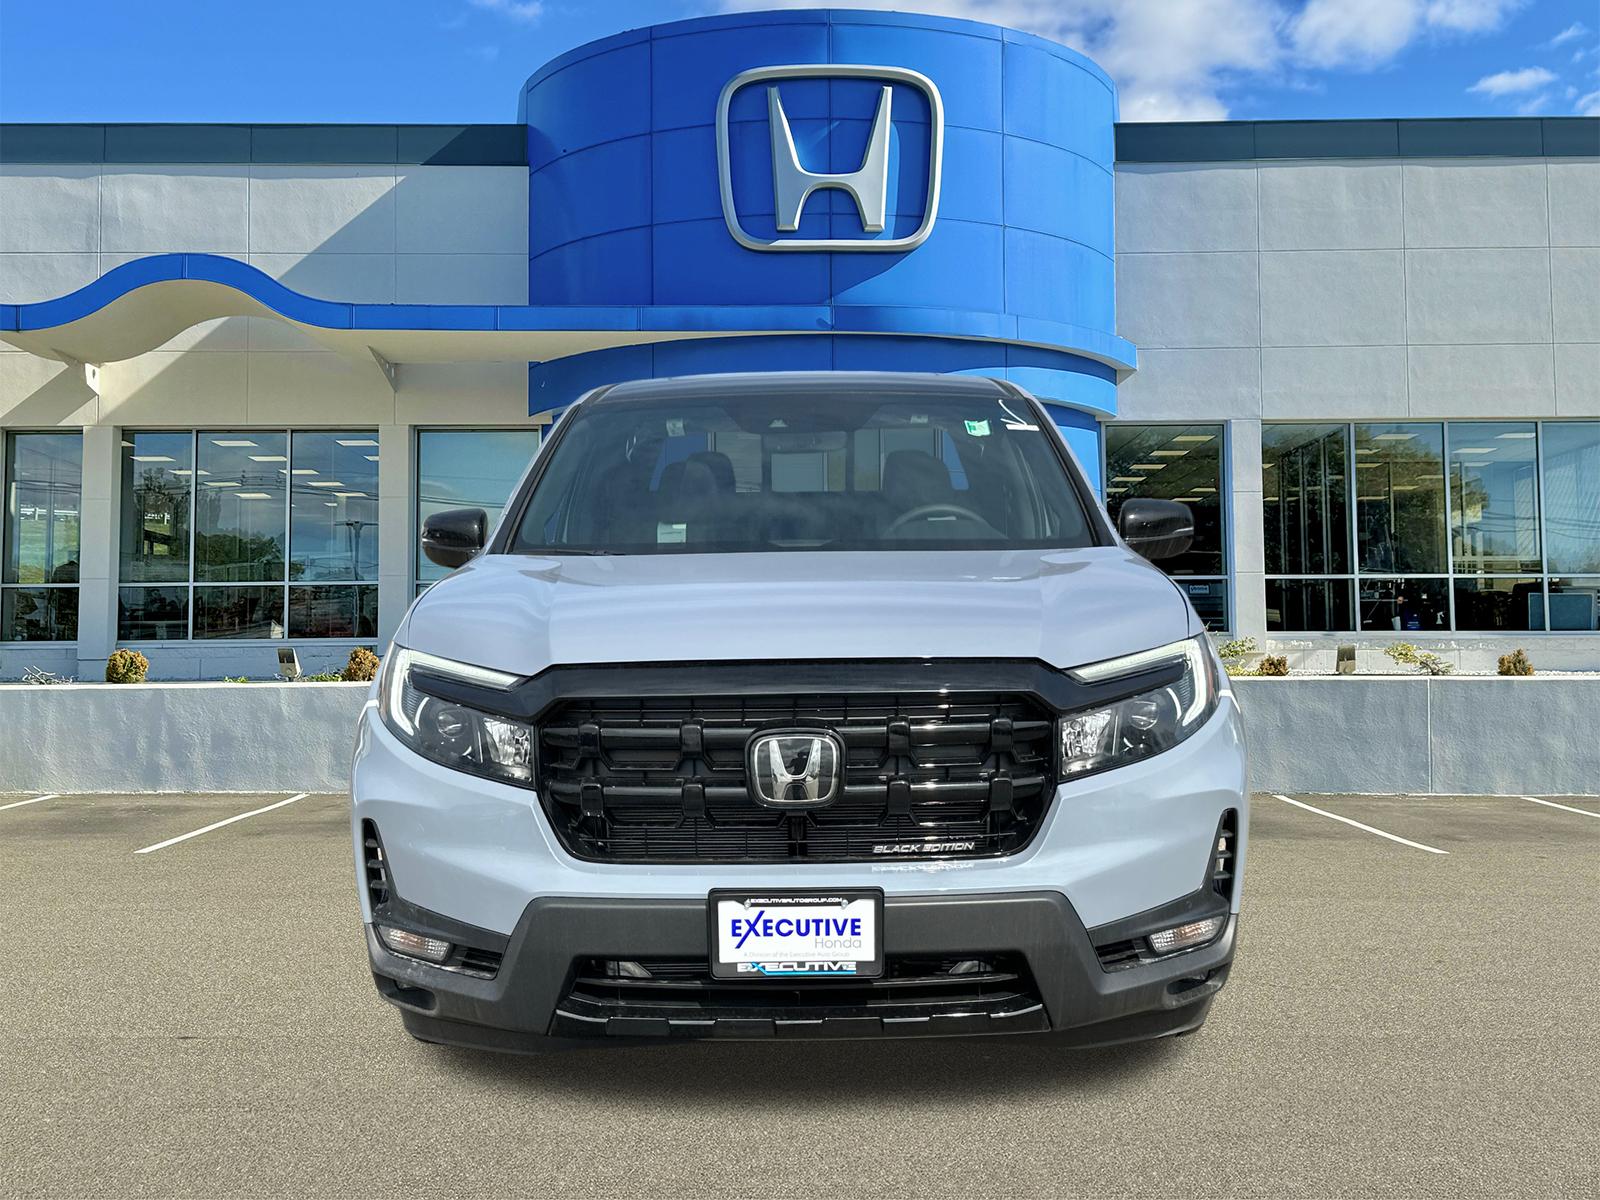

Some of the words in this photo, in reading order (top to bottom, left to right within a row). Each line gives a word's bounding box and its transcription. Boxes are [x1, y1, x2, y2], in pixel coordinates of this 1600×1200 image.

[872, 844, 920, 854] BLACK
[922, 842, 975, 852] EDITION
[731, 910, 862, 949] EXECUTIVE
[814, 937, 862, 949] Honda
[736, 961, 857, 975] EXECUTIVE
